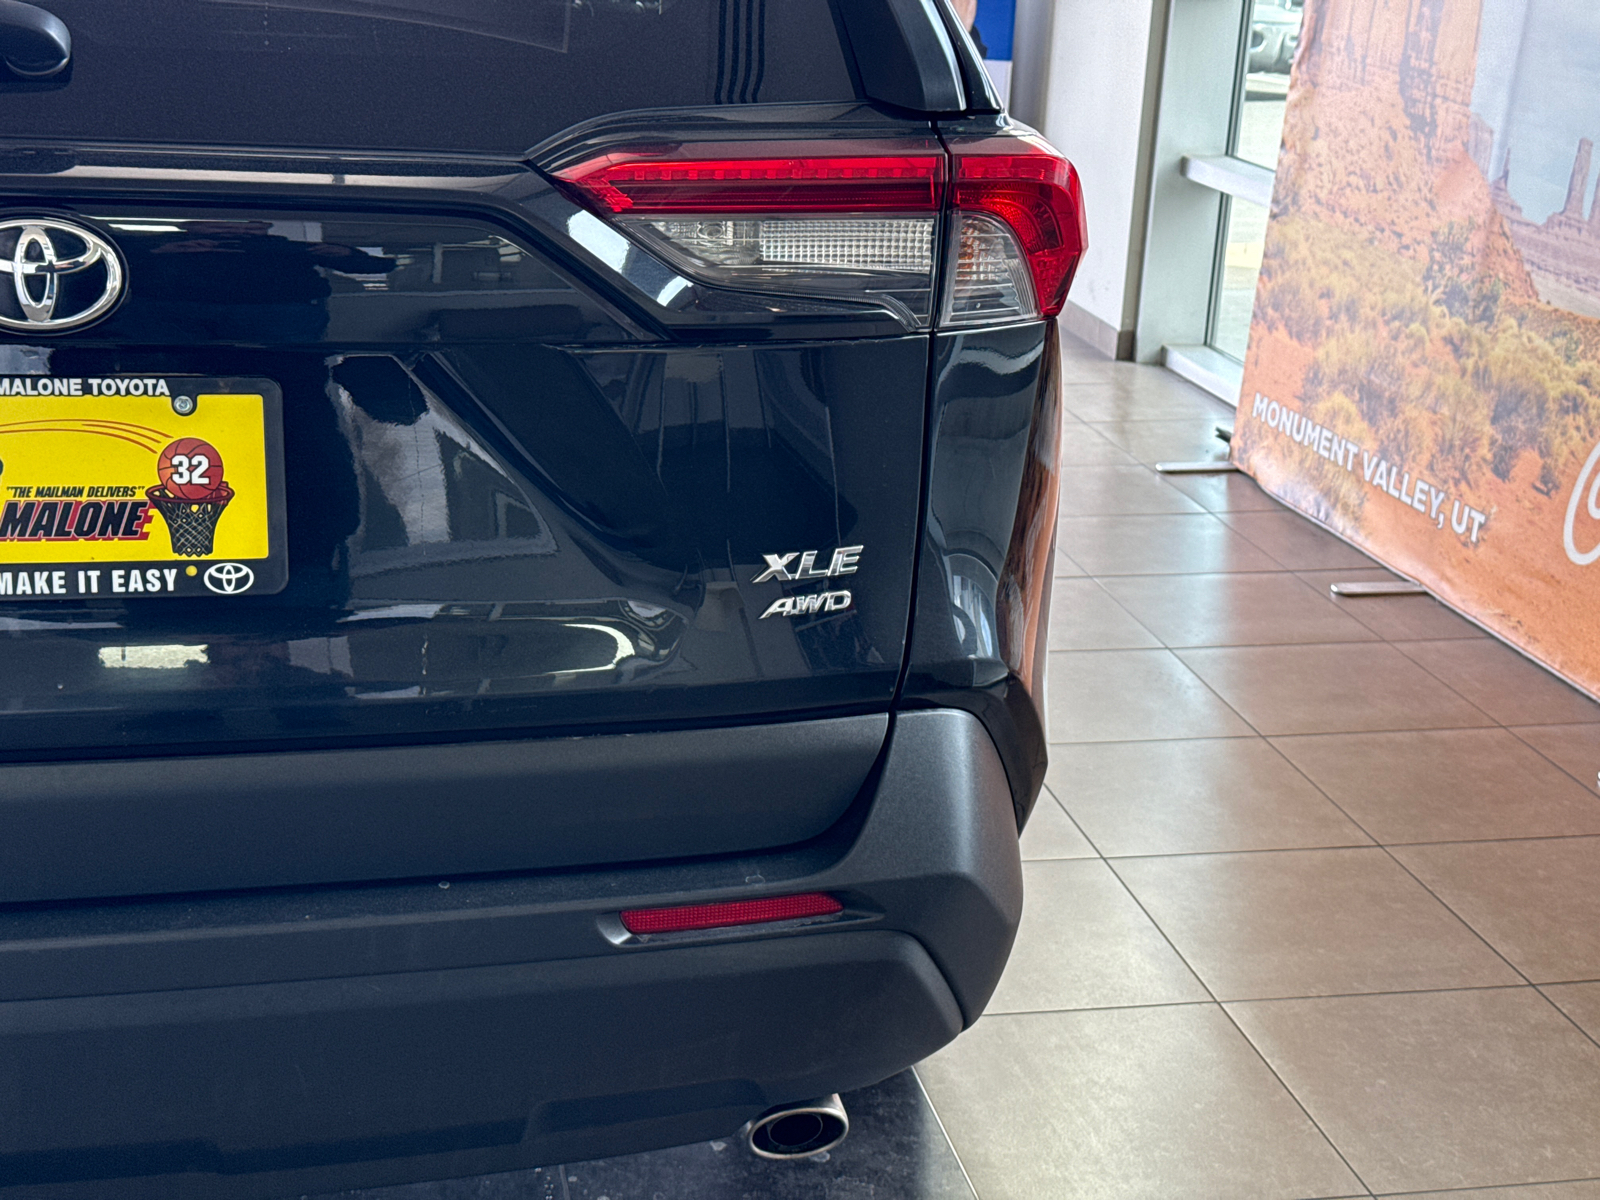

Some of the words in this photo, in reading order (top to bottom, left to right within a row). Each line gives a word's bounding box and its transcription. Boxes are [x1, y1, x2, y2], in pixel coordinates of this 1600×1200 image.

[88, 377, 170, 396] TOYOTA
[170, 454, 210, 485] 32
[1252, 392, 1359, 472] MONUMENT
[1361, 450, 1445, 530] VALLEY,
[1451, 499, 1486, 543] UT
[6, 486, 33, 498] "THE
[34, 486, 85, 498] MAILMAN
[86, 485, 146, 498] DELIVERS"
[0, 499, 151, 541] MALONE
[752, 545, 864, 583] XLE
[0, 570, 66, 595] MAKE
[77, 570, 101, 594] IT
[111, 568, 178, 593] EASY
[758, 590, 852, 619] AWD
